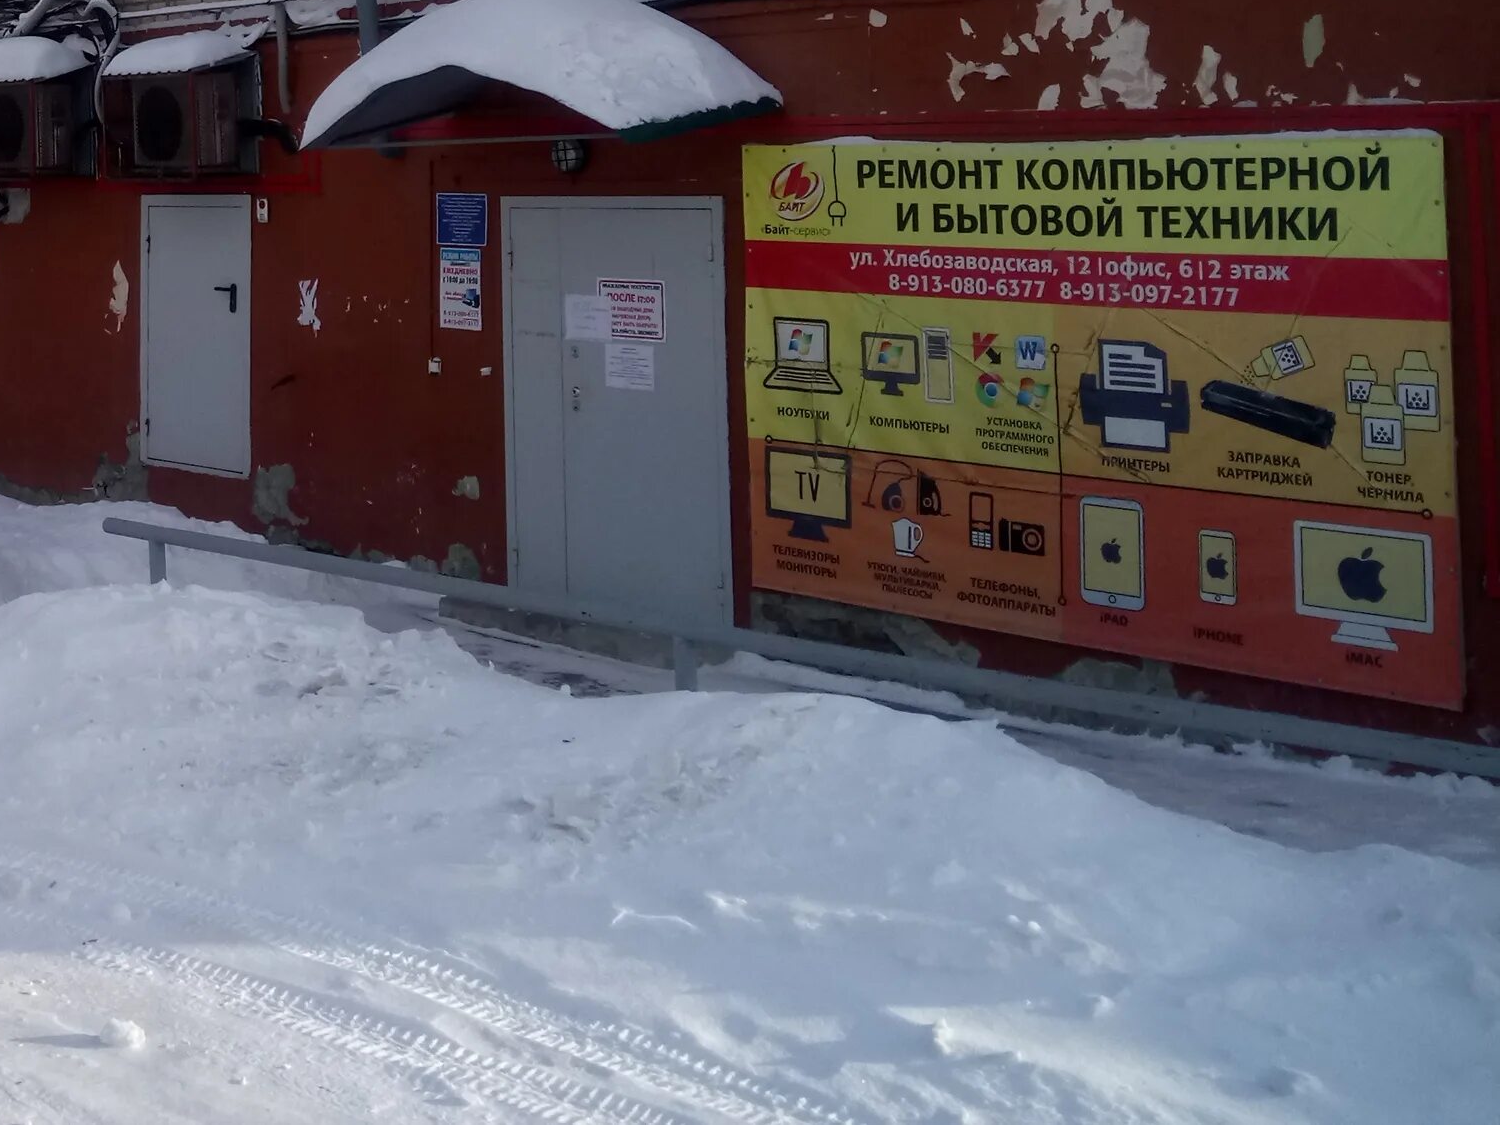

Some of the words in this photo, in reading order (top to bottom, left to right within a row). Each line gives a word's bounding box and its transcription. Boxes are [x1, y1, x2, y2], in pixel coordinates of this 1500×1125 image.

[857, 159, 1003, 190] РЕМОНТ
[1016, 146, 1390, 192] КОМПЬЮТЕРНОЙ
[896, 203, 919, 233] И
[933, 197, 1123, 237] БЫТОВОЙ
[1137, 205, 1338, 241] ТЕХНИКИ
[850, 253, 878, 271] ул.
[883, 248, 1060, 277] Хлебозаводская,
[1067, 255, 1091, 275] 12
[1179, 259, 1193, 277] 6
[1207, 260, 1221, 279] 2
[1230, 262, 1291, 282] этаж
[637, 295, 655, 304] 17:00
[889, 274, 1046, 300] 8-913-080-6377
[1060, 280, 1239, 307] 8-913-097-2177
[777, 406, 830, 422] НОУТБУКИ
[986, 416, 1042, 432] УСТАНОВКА
[869, 415, 950, 435] КОМПЬЮТЕРЫ
[975, 428, 1055, 445] ПРОГРАММНОГО
[981, 441, 1050, 458] ОБЕСПЕЧЕНИЯ
[1227, 450, 1301, 469] ЗАПРАВКА
[1101, 455, 1171, 475] ПРИНТЕРЫ
[794, 470, 821, 504] TV
[1217, 465, 1313, 488] КАРТРИДЖЕЙ
[1357, 486, 1425, 504] ЧЕРНИЛА
[772, 544, 841, 565] ТЕЛЕВИЗОРЫ
[776, 559, 838, 580] МОНИТОРЫ
[970, 577, 1041, 600] ТЕЛЕФОНЫ,
[956, 591, 1057, 618] ФОТОАППАРАТЫ
